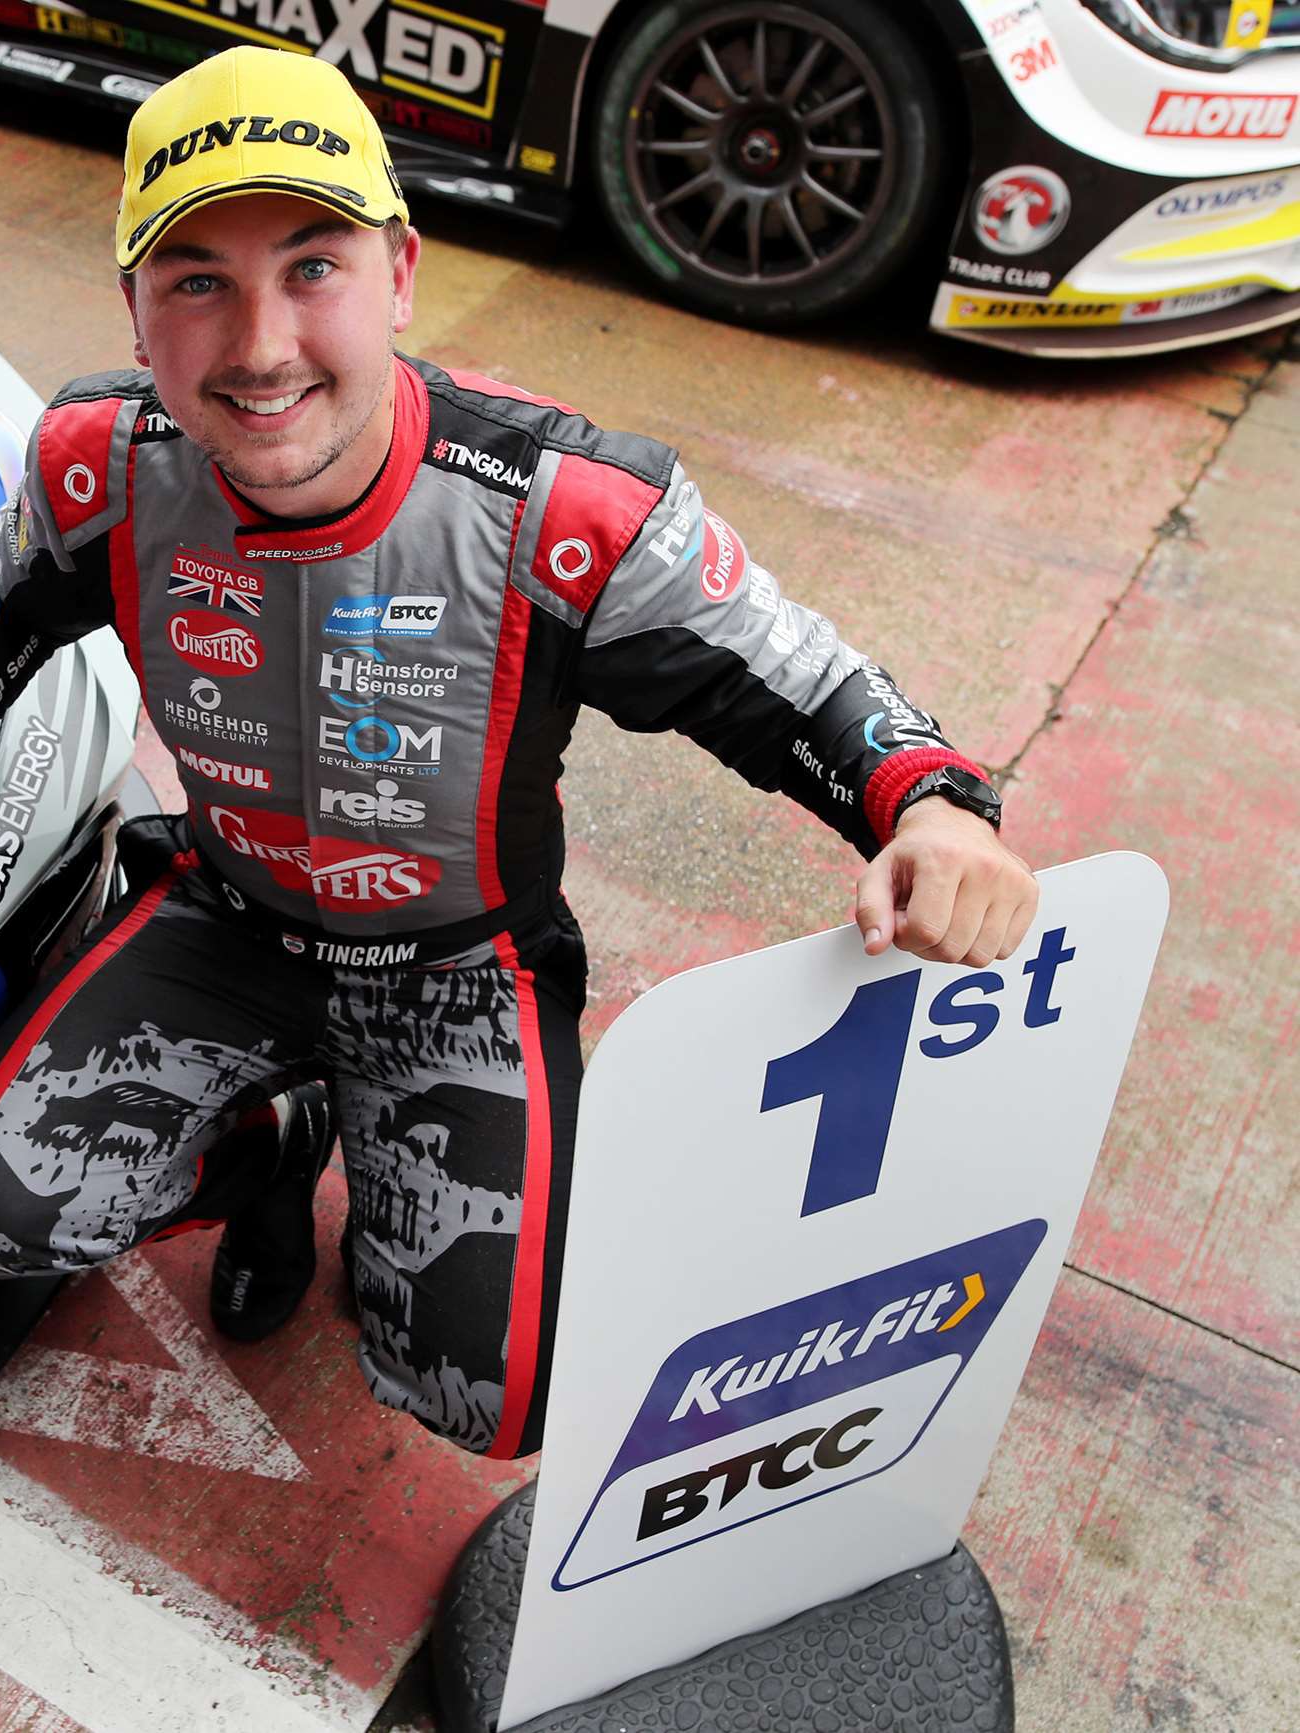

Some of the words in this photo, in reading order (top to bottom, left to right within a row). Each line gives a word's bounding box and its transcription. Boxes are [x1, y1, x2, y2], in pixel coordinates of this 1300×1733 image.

[1150, 95, 1294, 137] MOTUL
[140, 116, 351, 193] DUNLOP
[1157, 178, 1284, 217] OLYMPUS
[948, 256, 1004, 284] TRADE
[1004, 264, 1051, 289] CLUB
[984, 302, 1116, 318] DUNLOP
[432, 438, 534, 492] #TINGRAM
[245, 542, 344, 560] SPEEDWORKS
[177, 558, 234, 586] TOYOTA
[237, 575, 259, 591] GB
[390, 605, 438, 621] BTCC
[170, 616, 258, 668] GINSTERS
[356, 658, 458, 681] Hansford
[356, 675, 445, 698] Sensors
[164, 698, 268, 737] HEDGEHOG
[165, 714, 200, 732] CYBER
[206, 728, 268, 747] SECURITY
[318, 715, 442, 762] EOM
[178, 746, 270, 789] MOTUL
[318, 755, 414, 775] DEVELOPMENTS
[418, 767, 440, 775] LTD
[319, 779, 426, 823] reis
[319, 812, 375, 828] motorsport
[378, 819, 425, 829] insurance
[315, 942, 418, 967] TINGRAM
[636, 1407, 883, 1542] BTCC
